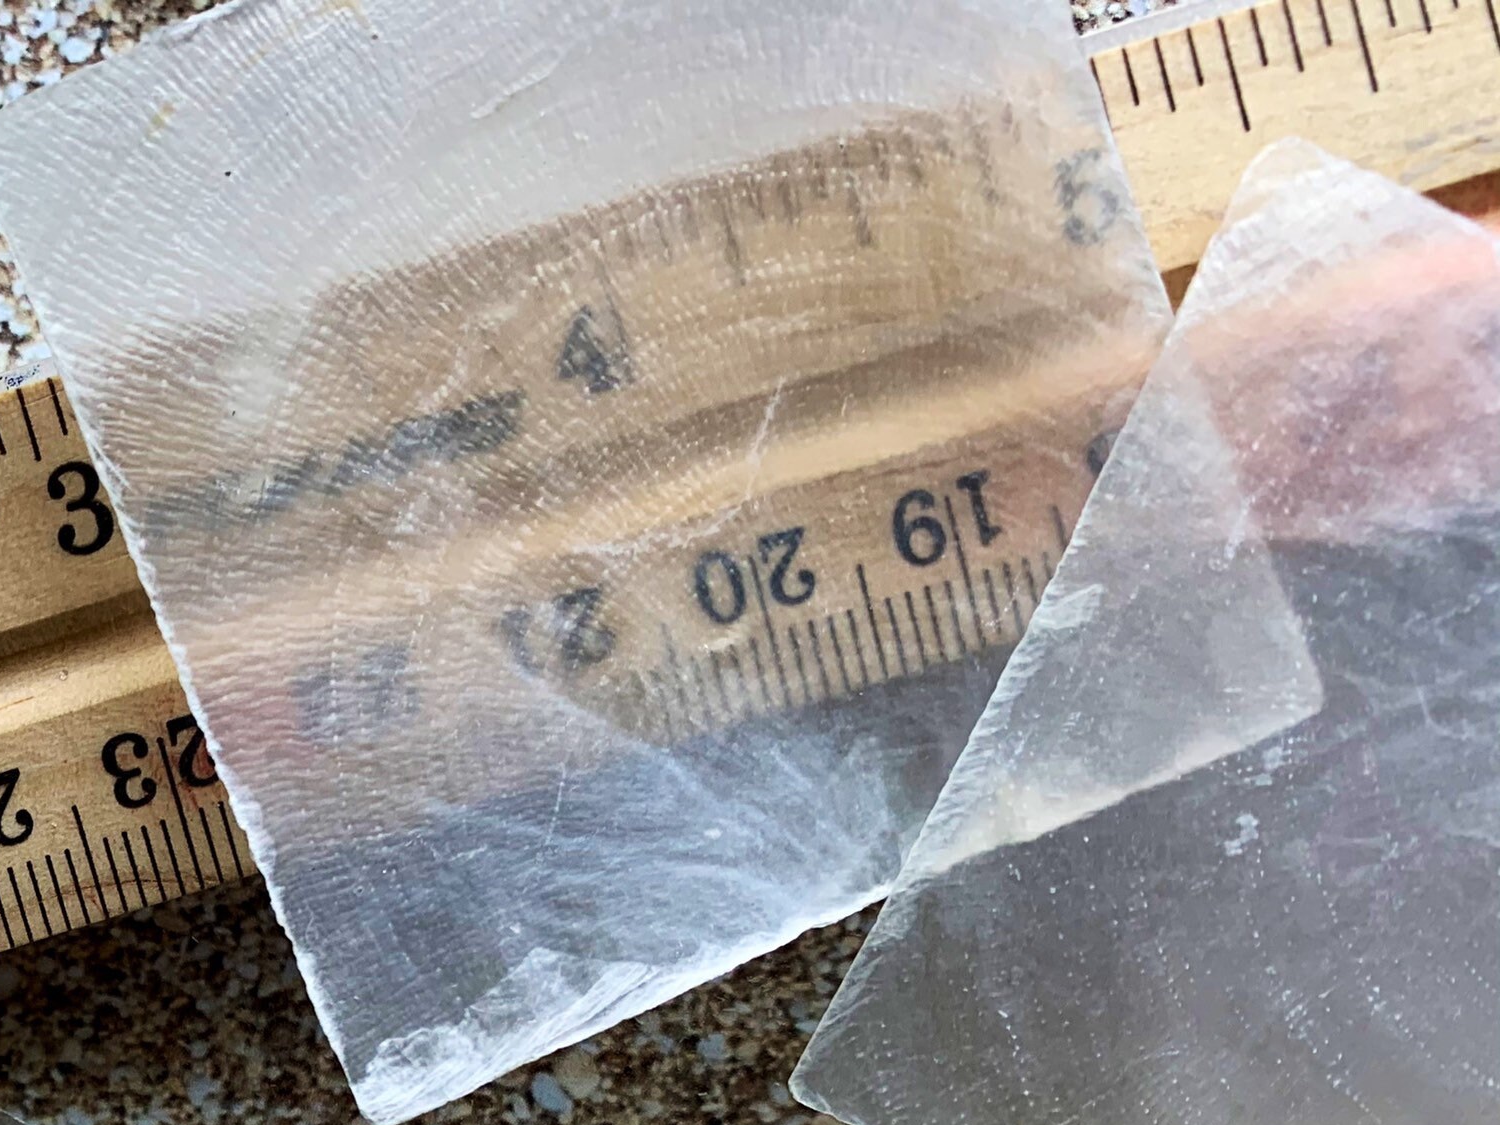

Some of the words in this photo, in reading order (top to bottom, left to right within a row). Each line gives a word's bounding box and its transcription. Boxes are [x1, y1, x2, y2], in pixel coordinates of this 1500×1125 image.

[48, 460, 115, 556] 3
[555, 304, 630, 395] 4
[892, 469, 1002, 567] 19
[693, 526, 816, 625] 20
[102, 714, 222, 808] 23
